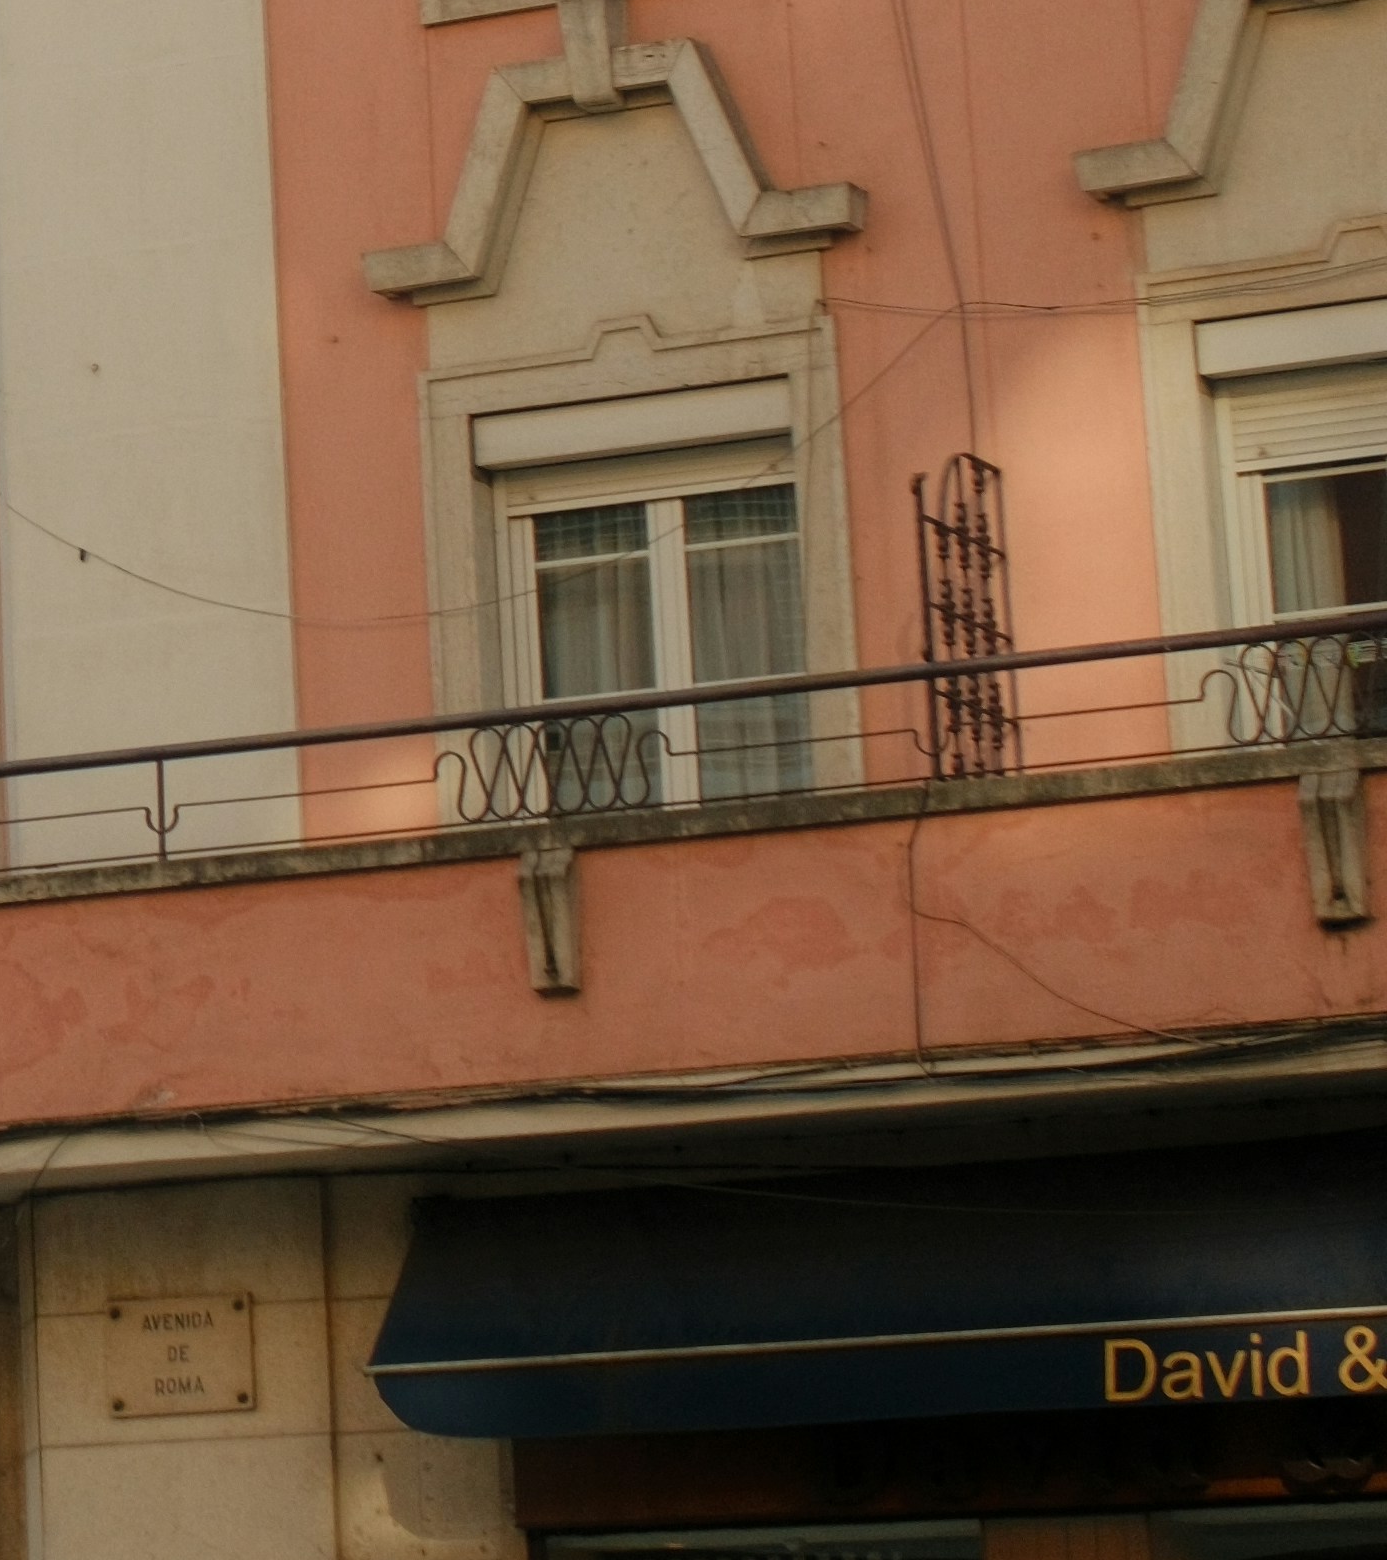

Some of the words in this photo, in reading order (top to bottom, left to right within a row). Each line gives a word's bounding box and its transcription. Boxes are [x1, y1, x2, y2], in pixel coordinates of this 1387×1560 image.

[141, 1309, 214, 1331] AVENIDA
[167, 1344, 190, 1362] DE
[1104, 1329, 1312, 1404] David
[1337, 1324, 1387, 1395] &
[154, 1375, 205, 1396] ROMA
